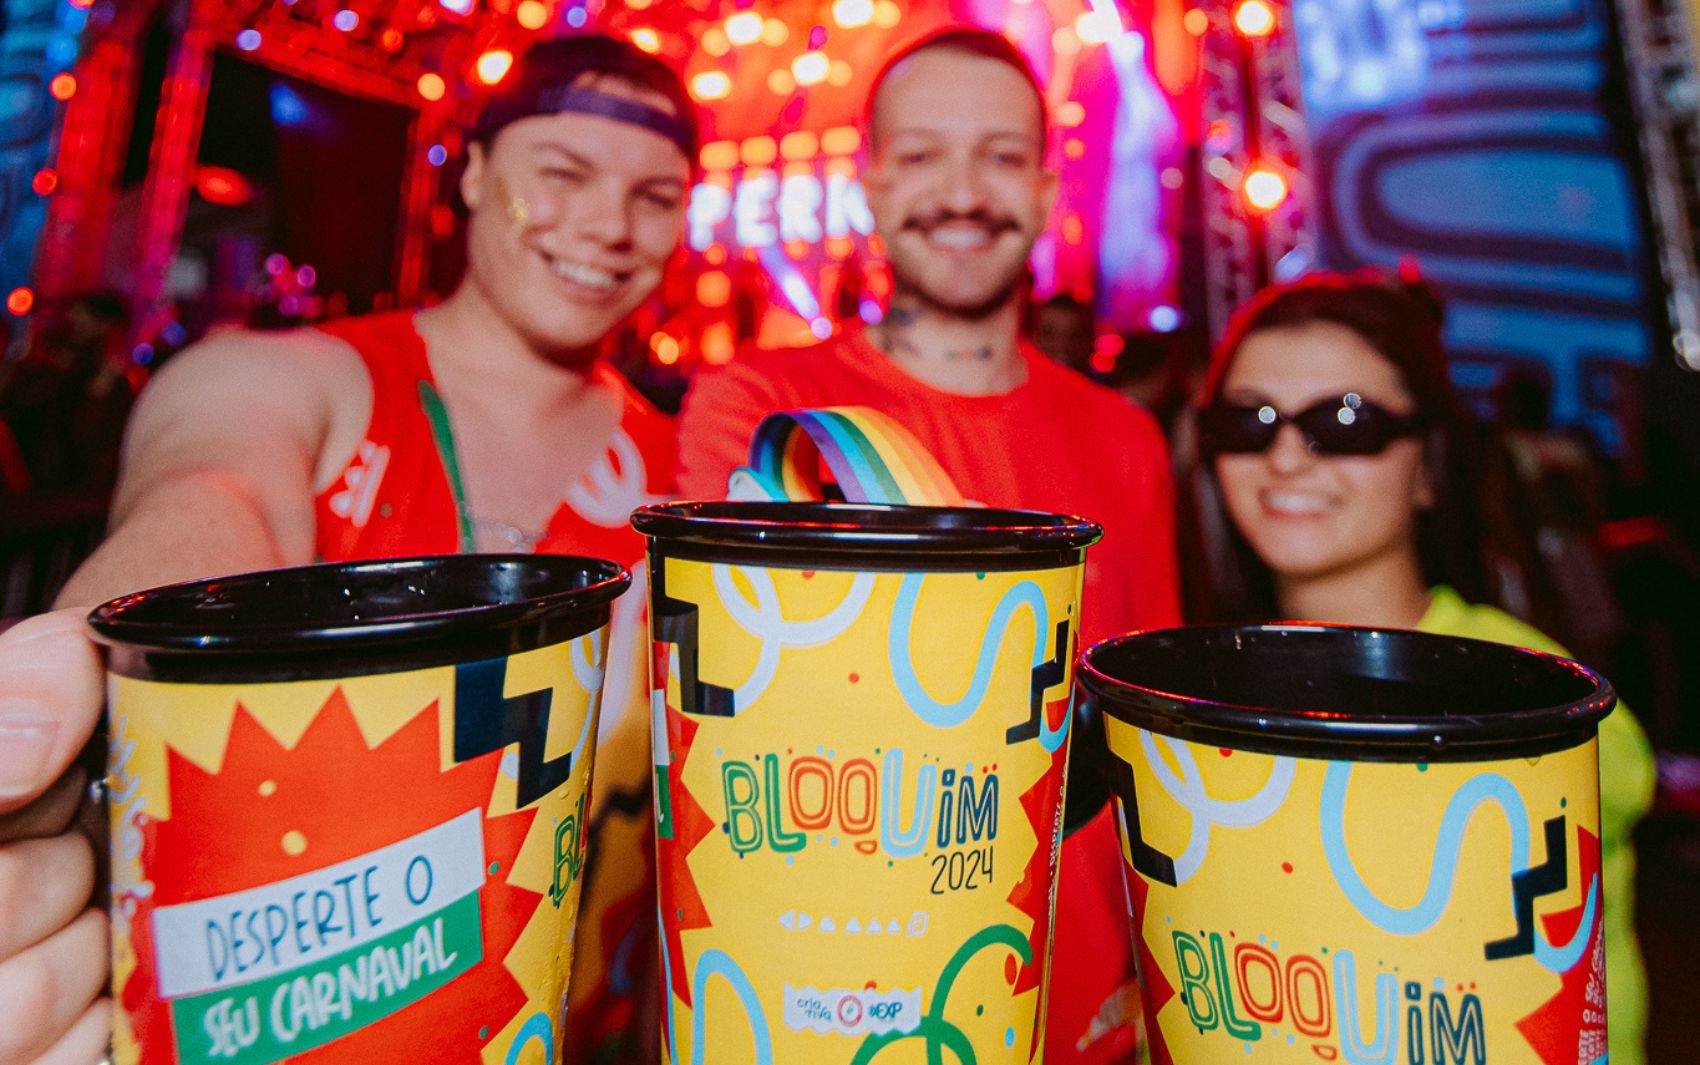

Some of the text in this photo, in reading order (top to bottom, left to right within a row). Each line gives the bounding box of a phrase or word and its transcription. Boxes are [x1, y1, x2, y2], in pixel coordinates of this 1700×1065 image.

[206, 855, 433, 982] DESPERTE O
[930, 846, 993, 895] 2024
[204, 916, 457, 1057] SEU CARNAVAL
